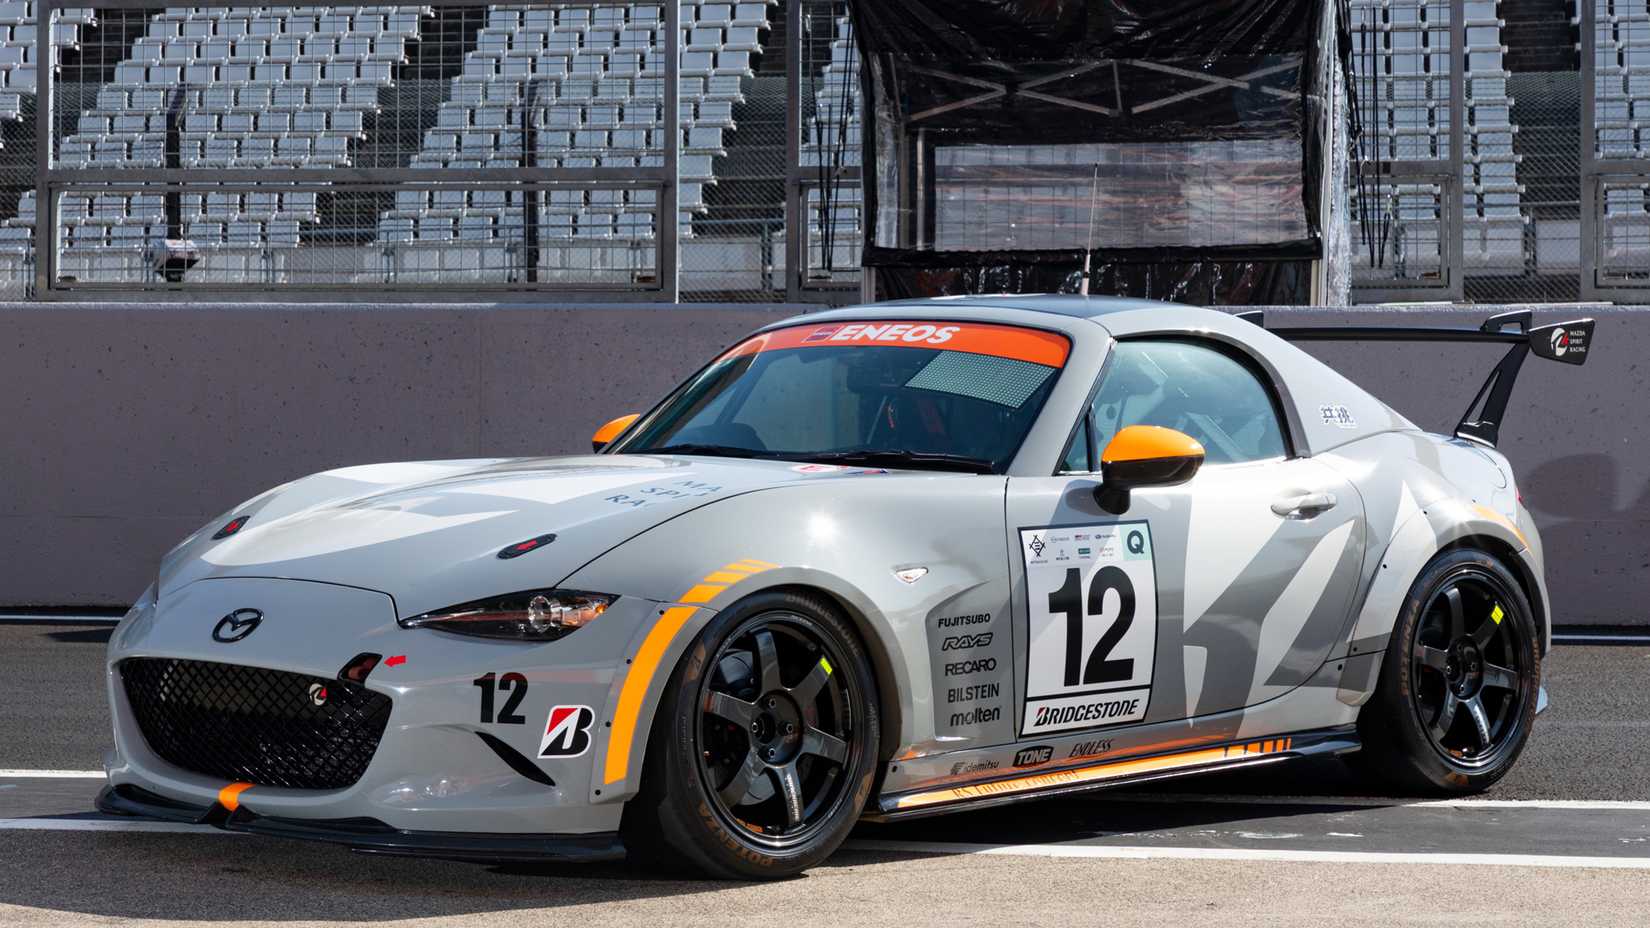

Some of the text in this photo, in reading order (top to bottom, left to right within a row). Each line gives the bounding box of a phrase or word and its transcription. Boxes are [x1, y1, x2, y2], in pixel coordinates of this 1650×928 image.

[829, 324, 961, 344] ENEOS
[1127, 530, 1145, 554] Q
[938, 613, 991, 629] FUJITSUBO
[1048, 566, 1136, 687] 12
[942, 632, 993, 651] RAYS
[945, 658, 997, 676] RECARO
[473, 672, 528, 724] 12
[948, 683, 1000, 703] BILSTEIN
[950, 706, 1000, 727] molten
[1034, 698, 1140, 727] BRIDGESTONE
[1016, 747, 1052, 766] TONE
[1068, 739, 1114, 758] ENDLESS
